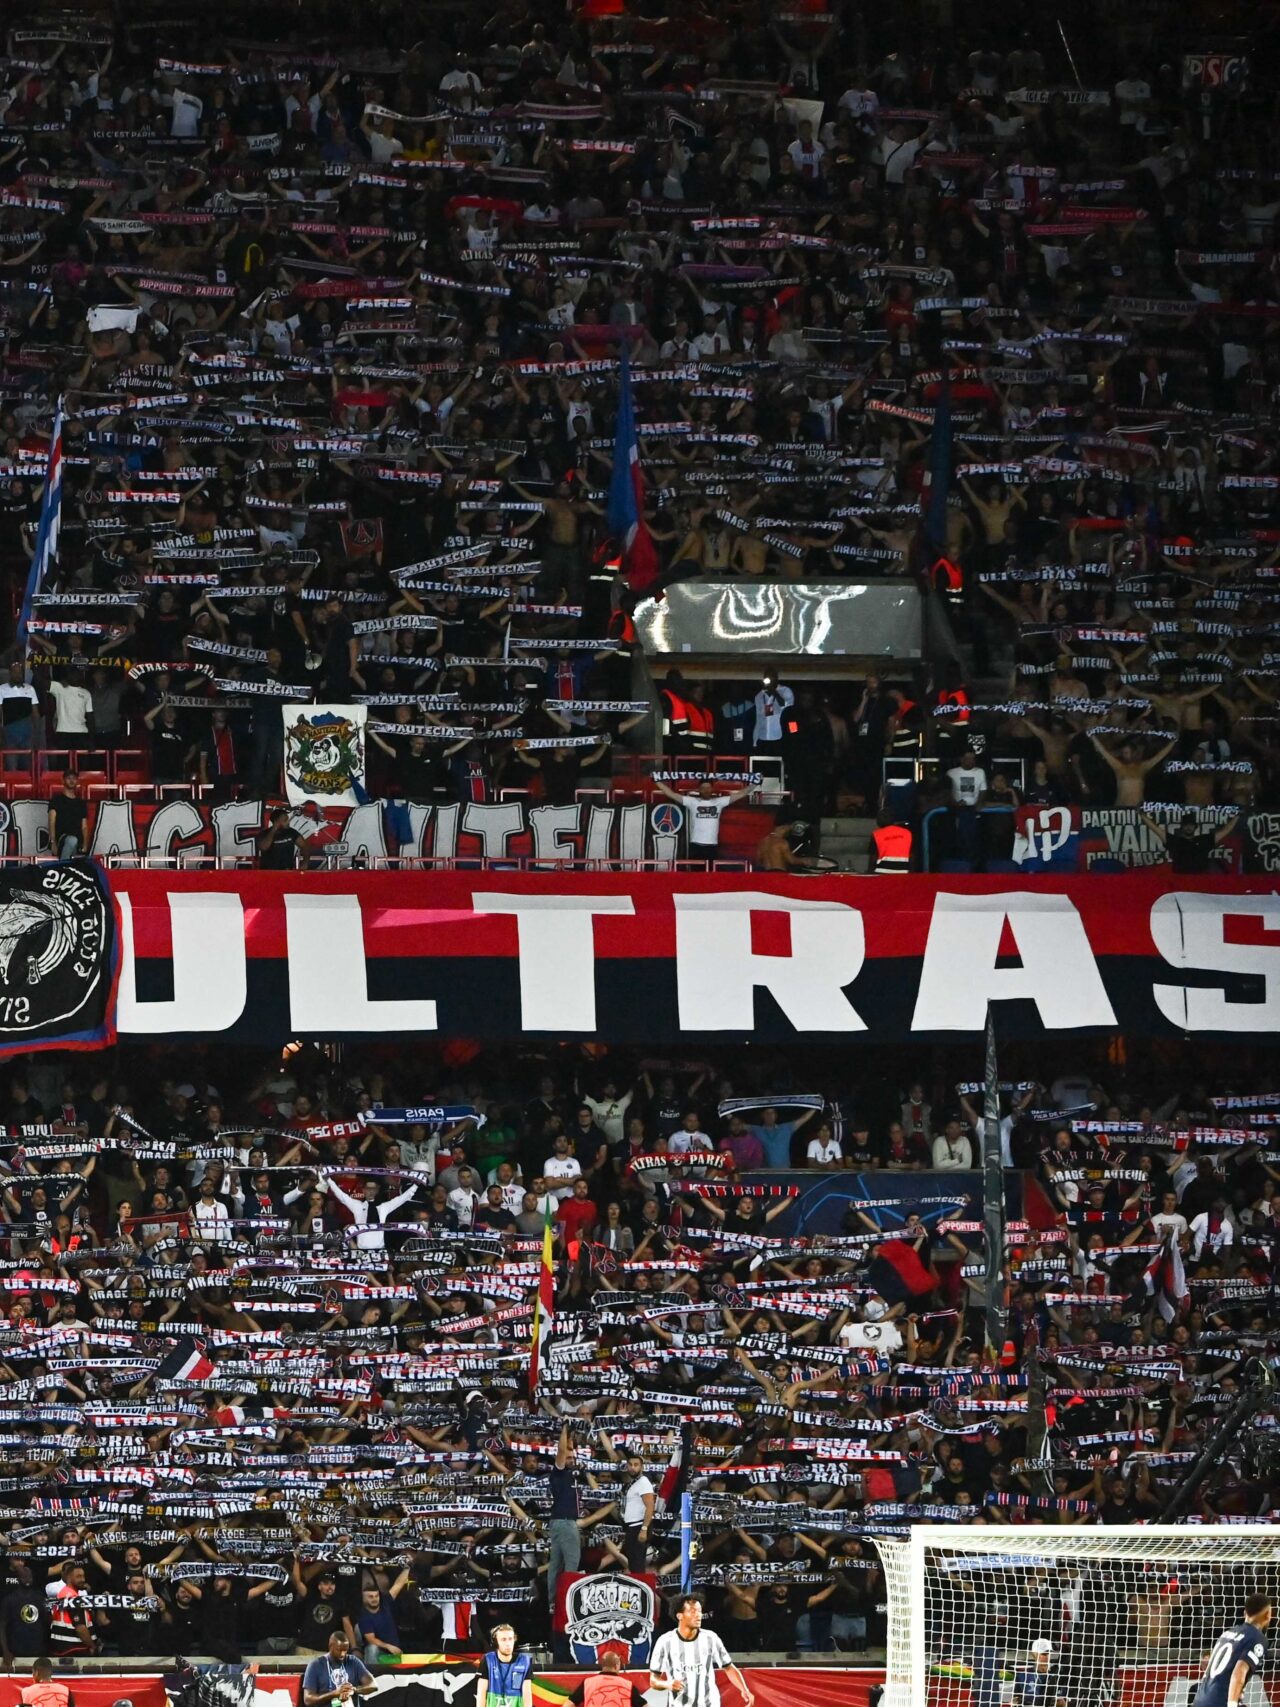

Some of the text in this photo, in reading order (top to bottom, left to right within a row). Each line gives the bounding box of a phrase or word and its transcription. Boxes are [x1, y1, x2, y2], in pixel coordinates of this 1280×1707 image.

[109, 492, 180, 504] ULTRAS
[145, 575, 219, 585] ULTRAS
[28, 621, 102, 634] PARIS
[653, 771, 715, 781] NAUTECIA
[115, 890, 1280, 1034] ULTRAS
[1073, 1121, 1143, 1132] PARIS
[135, 1150, 175, 1160] VIRAGE
[4, 1279, 79, 1292] ULTRAS
[235, 1302, 318, 1313] PARIS
[96, 1319, 138, 1331] VIRAGE
[158, 1323, 202, 1335] AUTEUIL
[789, 1347, 844, 1364] MERDA
[1102, 1346, 1167, 1357] PARIS
[51, 1358, 160, 1369] VIRAGE AUTEUIL
[75, 1470, 154, 1487] ULTRAS
[99, 1501, 143, 1515] VIRAGE
[166, 1506, 214, 1519] AUTEUIL
[37, 1546, 76, 1556] 2021
